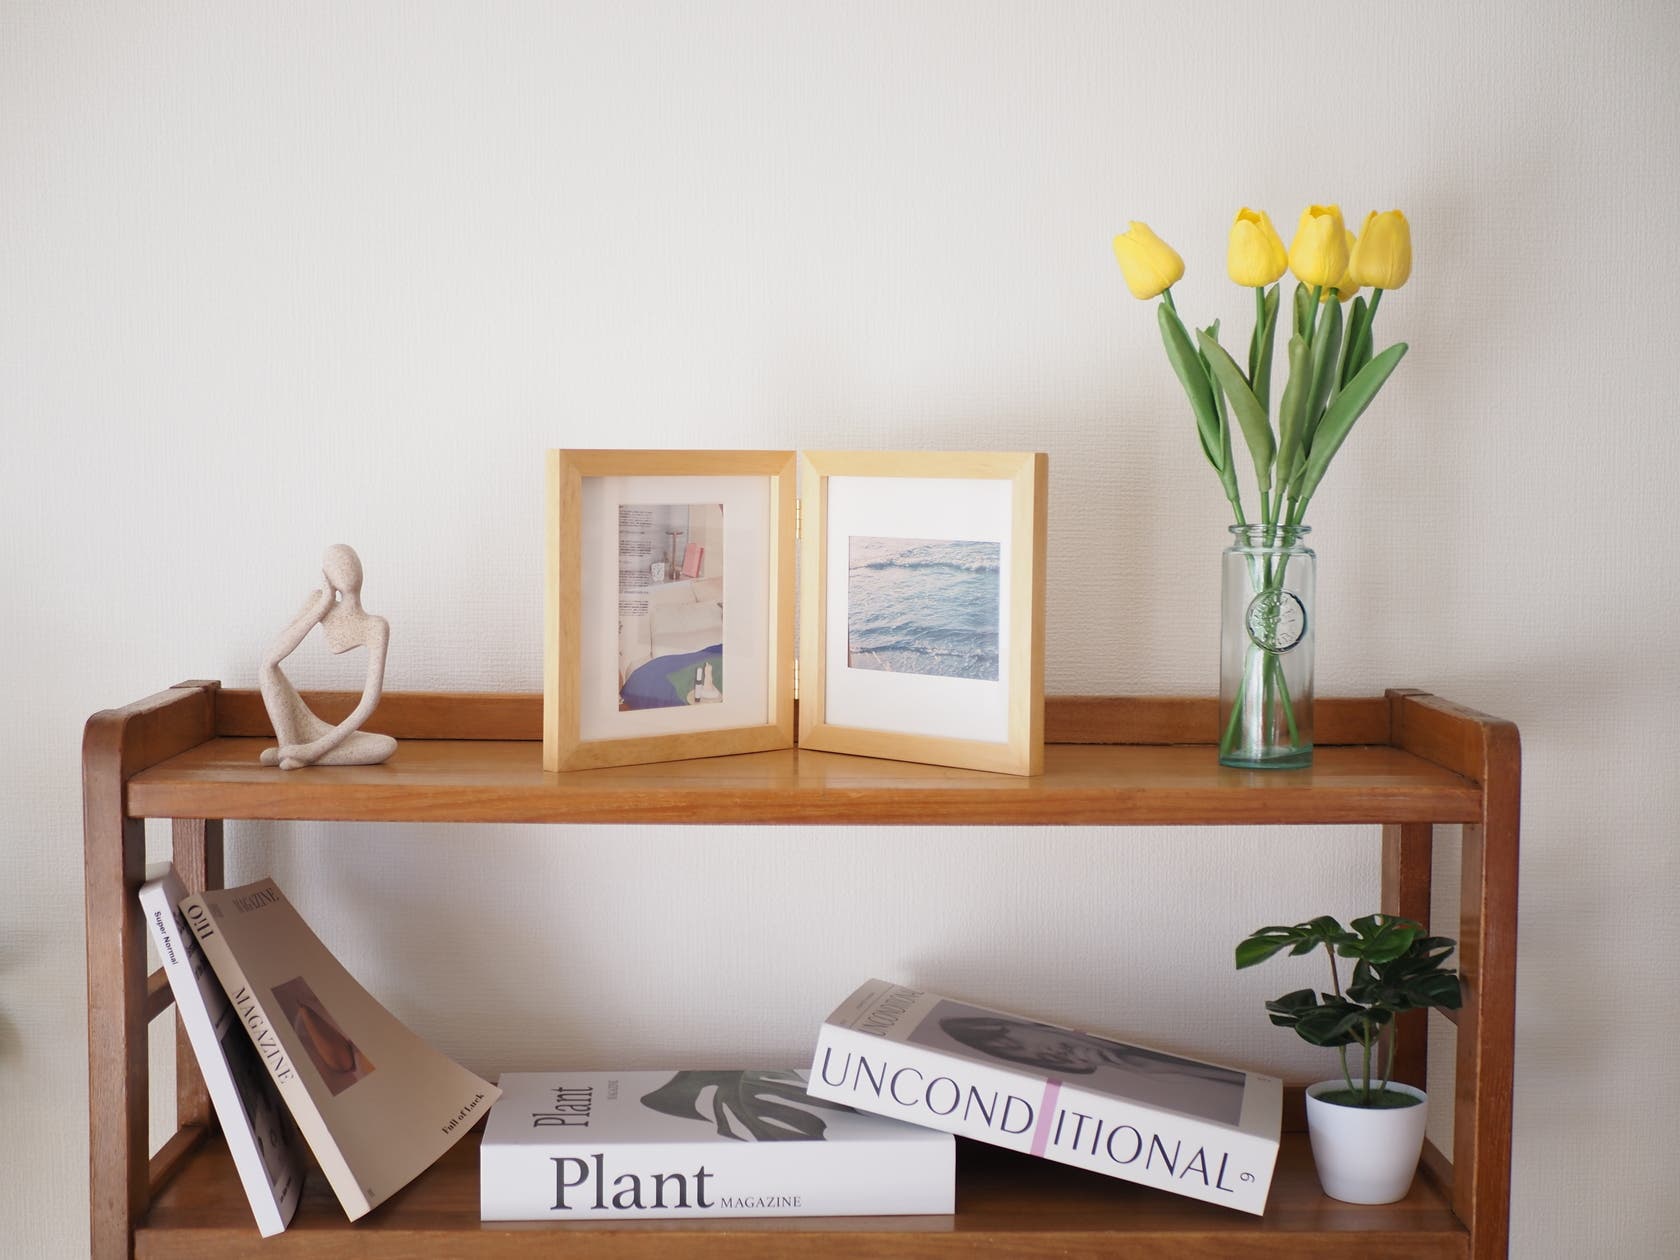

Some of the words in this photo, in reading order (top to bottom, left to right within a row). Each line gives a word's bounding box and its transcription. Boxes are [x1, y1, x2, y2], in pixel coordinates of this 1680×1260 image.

[154, 911, 167, 935] Super
[163, 936, 178, 965] Normal
[233, 987, 294, 1084] MAGAZINE
[441, 1119, 459, 1135] Full
[458, 1110, 467, 1121] of
[464, 1094, 485, 1112] Luck
[532, 1086, 593, 1128] Plant
[549, 1153, 715, 1212] Plant
[720, 1195, 802, 1210] MAGAZINE
